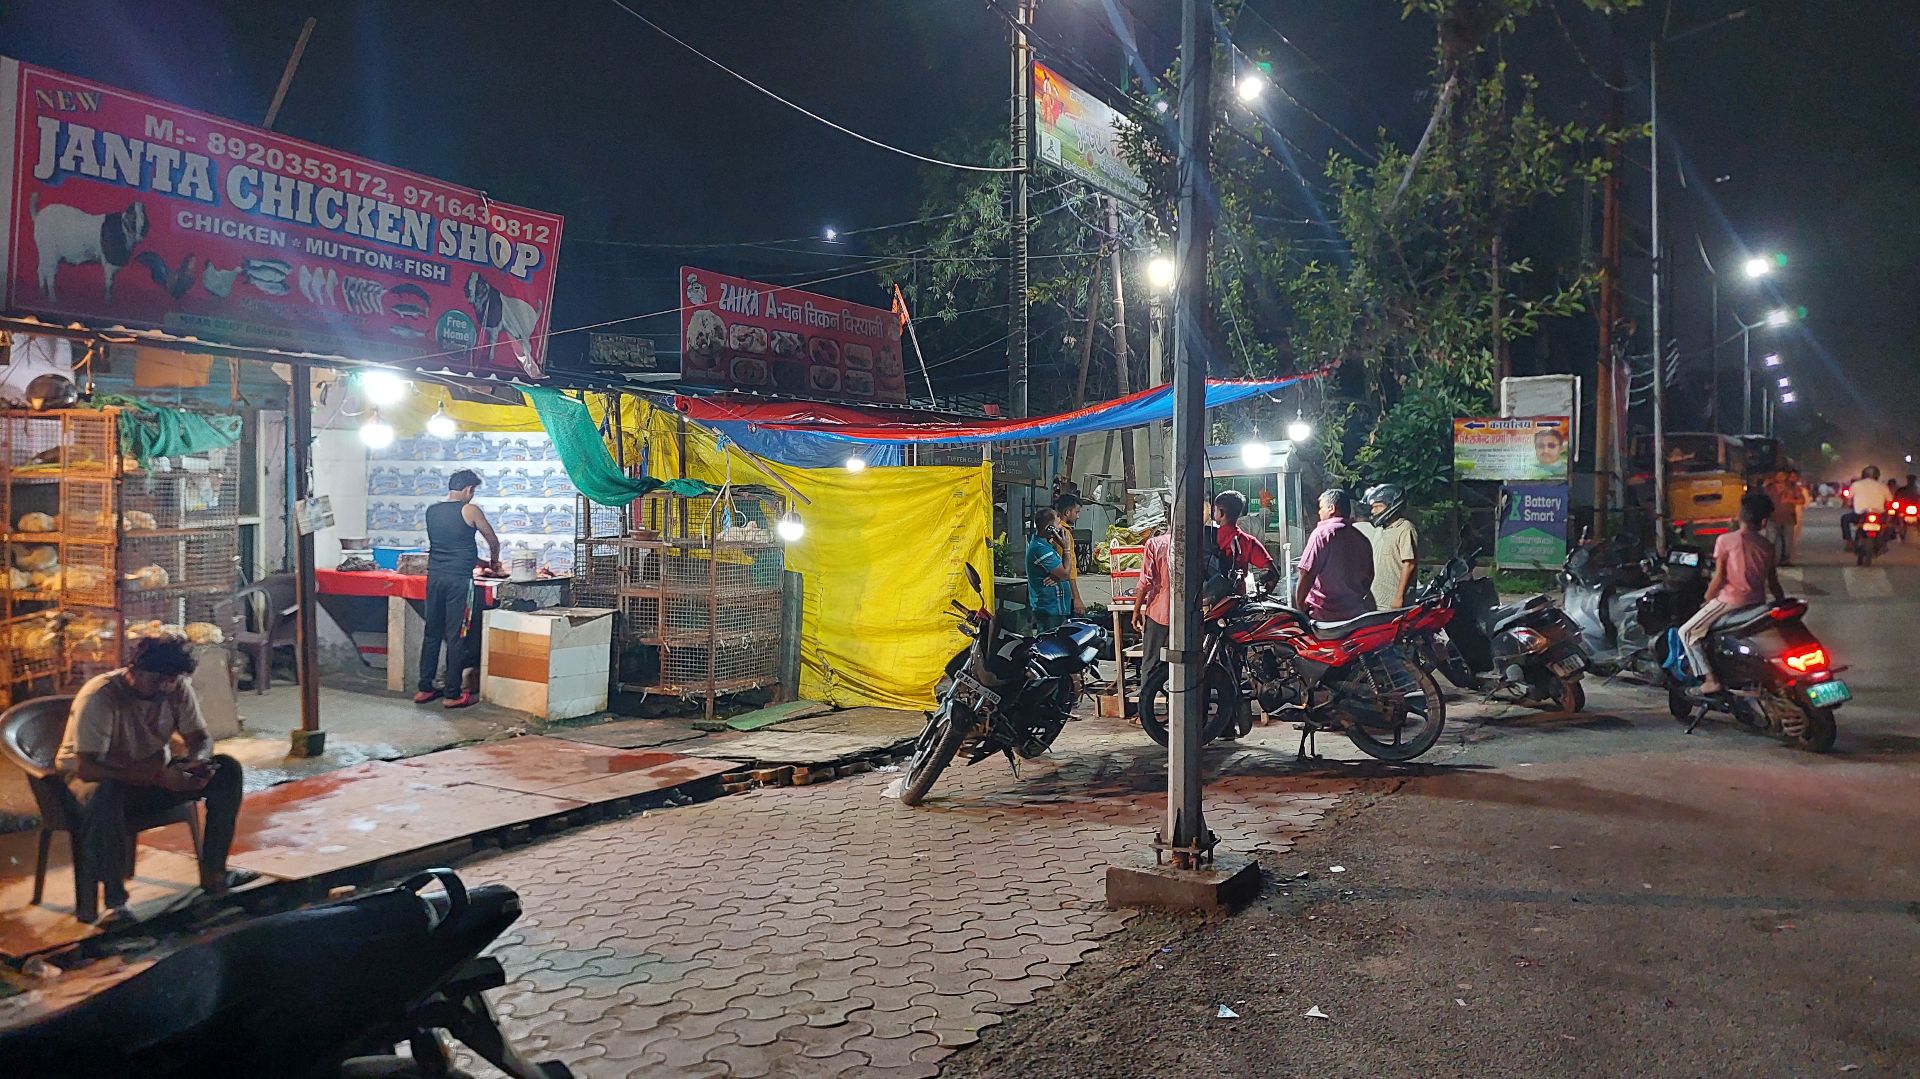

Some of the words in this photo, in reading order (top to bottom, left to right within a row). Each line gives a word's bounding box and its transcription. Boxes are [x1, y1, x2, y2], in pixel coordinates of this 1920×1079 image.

[35, 89, 99, 112] NEW
[144, 114, 197, 146] M:-
[206, 132, 395, 203] 8920353172,
[403, 185, 550, 245] 9716430812
[33, 115, 214, 202] JANTA
[225, 164, 431, 252] CHICKEN
[438, 218, 541, 279] SHOP
[177, 210, 286, 248] CHICKEN
[305, 237, 394, 270] MUTTON
[404, 258, 447, 281] FISH
[718, 282, 760, 317] ZAIKA
[443, 327, 470, 341] Home
[446, 316, 467, 329] Free
[1524, 494, 1562, 511] Battery
[1524, 508, 1555, 522] Smart
